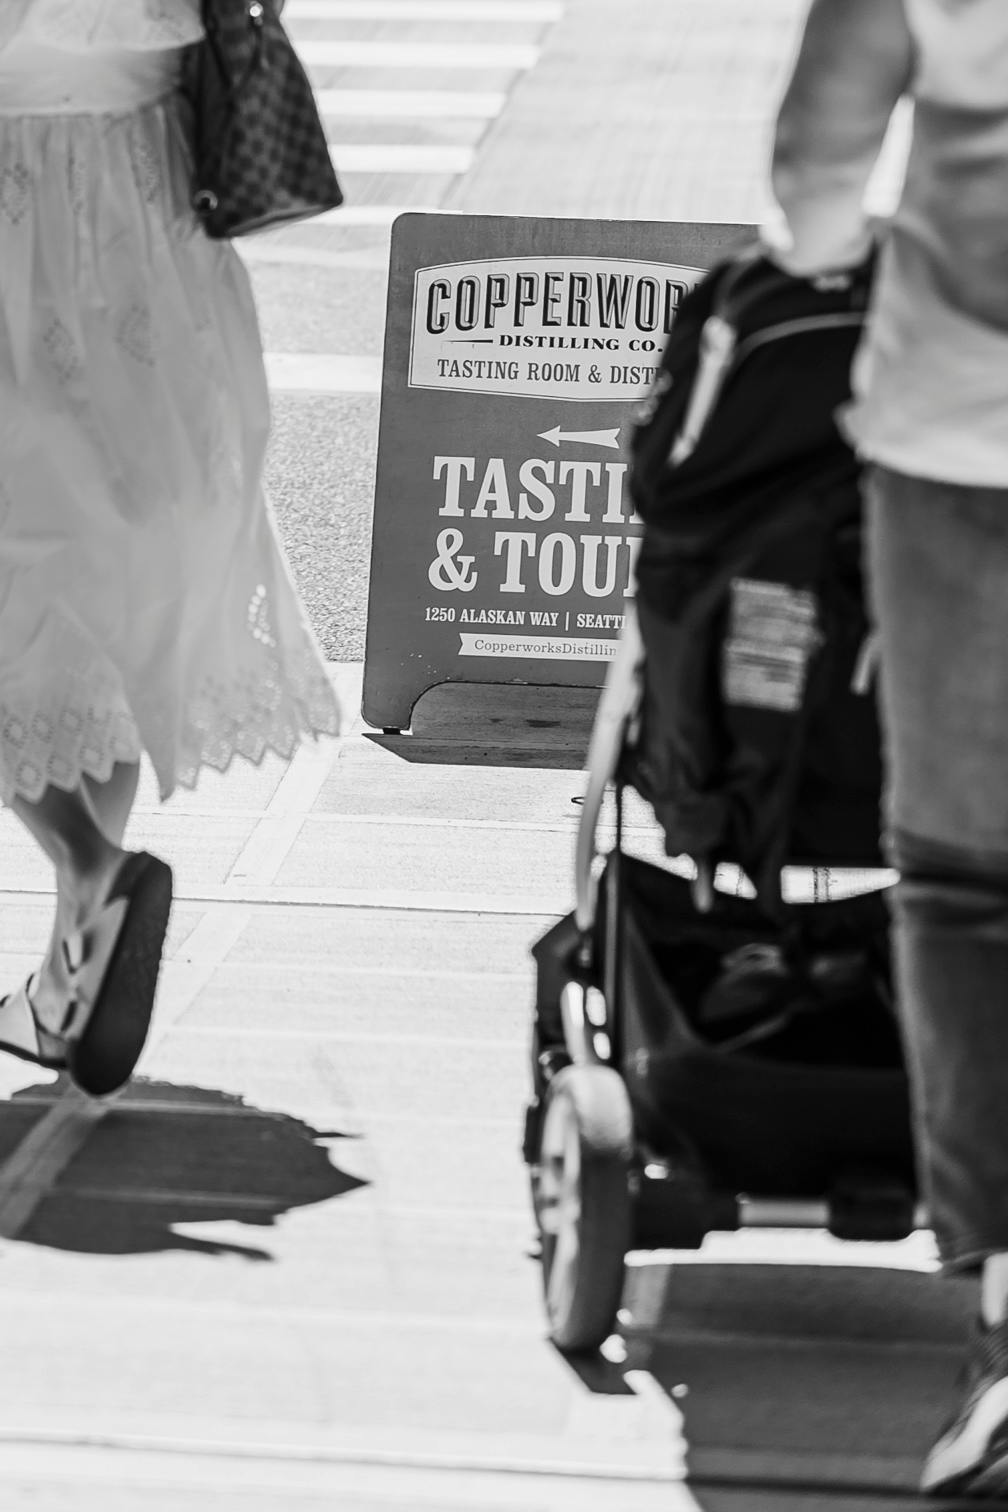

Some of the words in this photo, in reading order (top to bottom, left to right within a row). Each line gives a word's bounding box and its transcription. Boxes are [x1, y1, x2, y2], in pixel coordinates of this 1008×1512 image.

[426, 271, 702, 335] COPPERWOR
[499, 334, 620, 351] DISTILLING
[628, 339, 664, 353] CO.
[437, 358, 520, 381] TASTING
[526, 362, 581, 383] ROOM
[588, 364, 602, 384] &
[433, 455, 644, 525] TASTI
[428, 527, 478, 592] &
[425, 607, 456, 623] 1250
[459, 609, 526, 626] ALASKAN
[529, 612, 559, 627] WAY
[474, 639, 619, 657] CopperworksDistillin
